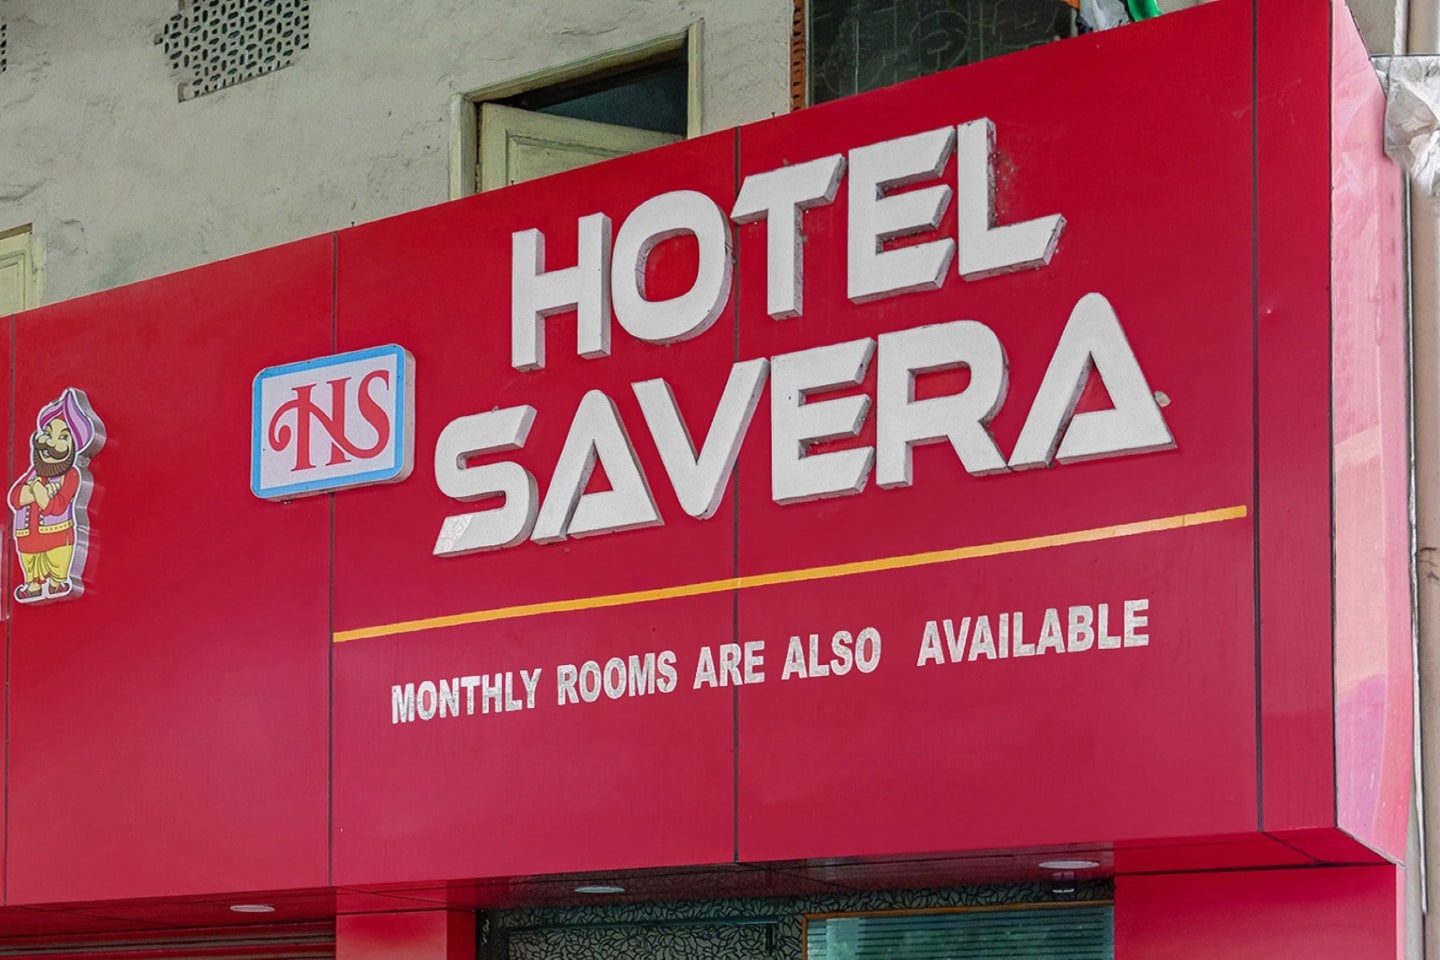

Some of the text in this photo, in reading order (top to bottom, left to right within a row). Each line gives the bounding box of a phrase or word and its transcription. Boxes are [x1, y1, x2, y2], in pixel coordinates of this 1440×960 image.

[511, 116, 1067, 373] HOTEL
[432, 292, 1177, 558] SAVERA
[392, 599, 1149, 724] MONTHLY ROOMS ARE ALSO AVAILABLE
